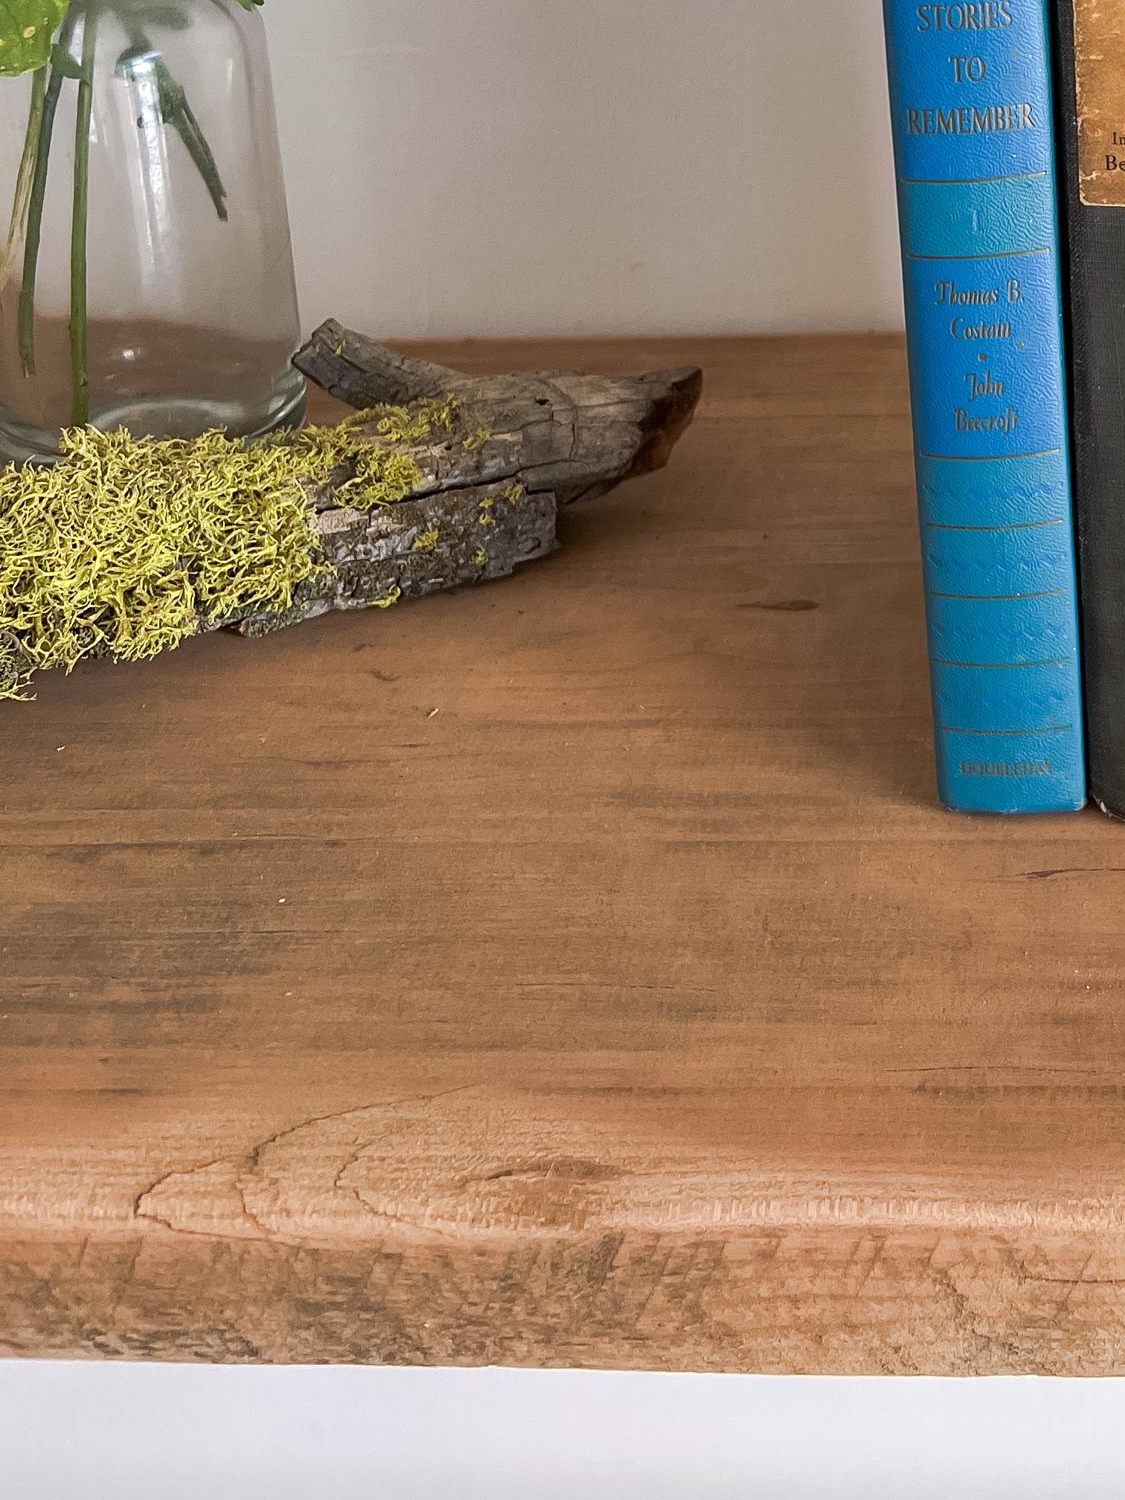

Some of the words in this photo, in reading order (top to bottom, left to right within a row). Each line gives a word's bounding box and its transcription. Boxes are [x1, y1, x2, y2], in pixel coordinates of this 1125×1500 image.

[916, 0, 1013, 33] STORIES
[948, 55, 987, 84] TO
[907, 102, 1036, 135] REMEMBER
[934, 279, 1000, 306] Thomas
[963, 371, 1005, 403] John
